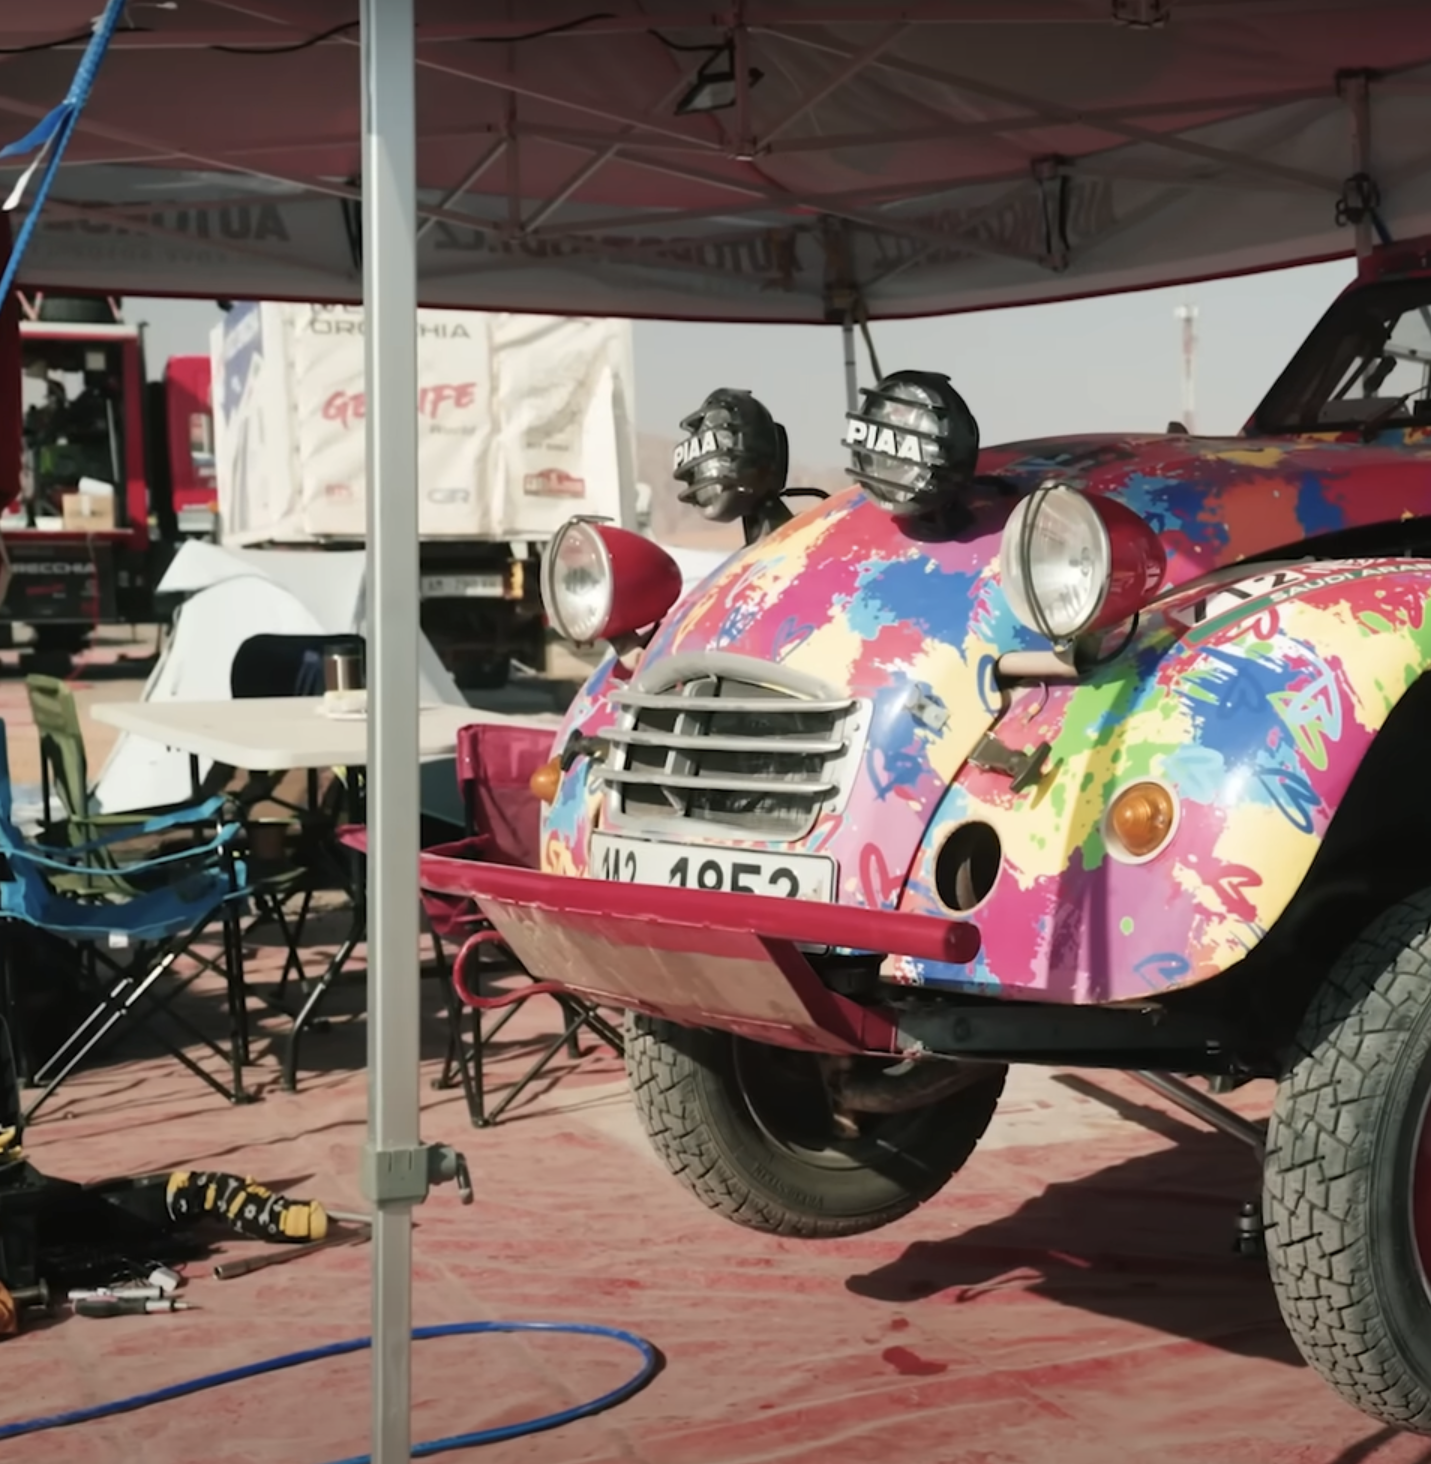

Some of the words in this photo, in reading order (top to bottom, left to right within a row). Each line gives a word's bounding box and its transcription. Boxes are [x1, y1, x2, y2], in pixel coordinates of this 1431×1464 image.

[311, 318, 472, 339] ORHIA
[321, 381, 478, 430] GEIFE
[673, 430, 718, 469] PIAA
[846, 418, 922, 463] PIAA
[1269, 571, 1356, 603] SAUDI
